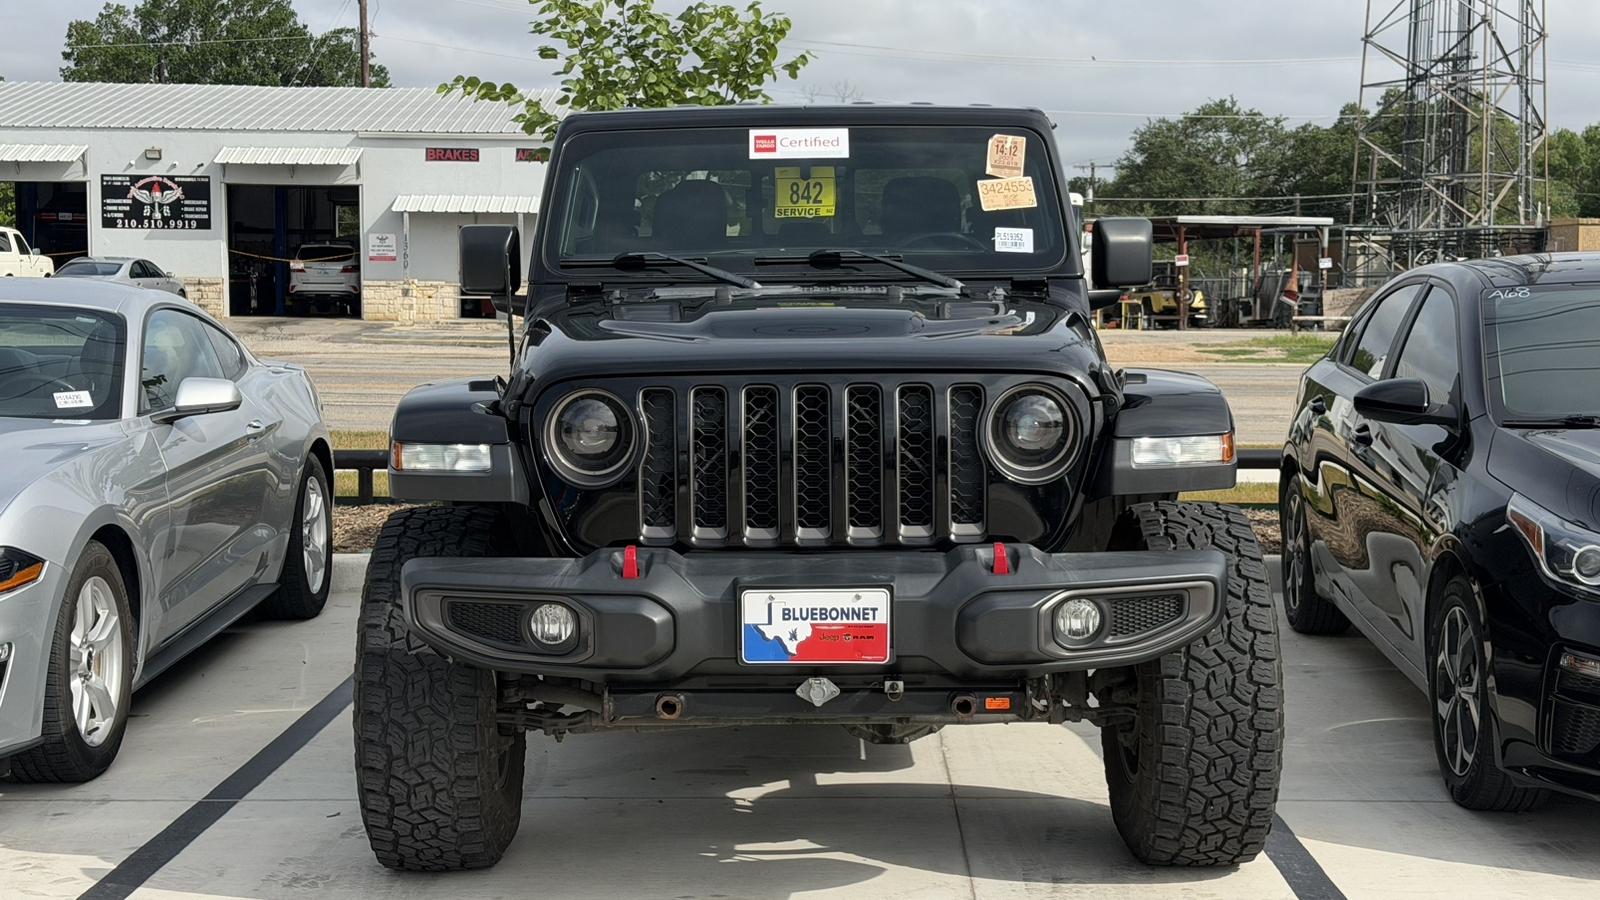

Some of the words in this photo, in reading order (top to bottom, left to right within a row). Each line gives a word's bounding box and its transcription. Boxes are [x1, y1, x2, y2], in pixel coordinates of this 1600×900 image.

[780, 136, 840, 148] Certified
[427, 149, 479, 161] BRAKES
[789, 181, 823, 205] 842
[981, 180, 1032, 195] 3424553
[776, 207, 821, 217] SERVICE
[116, 219, 197, 228] 210.510.9919
[782, 607, 878, 621] BLUEBONNET
[819, 633, 840, 642] Jeep
